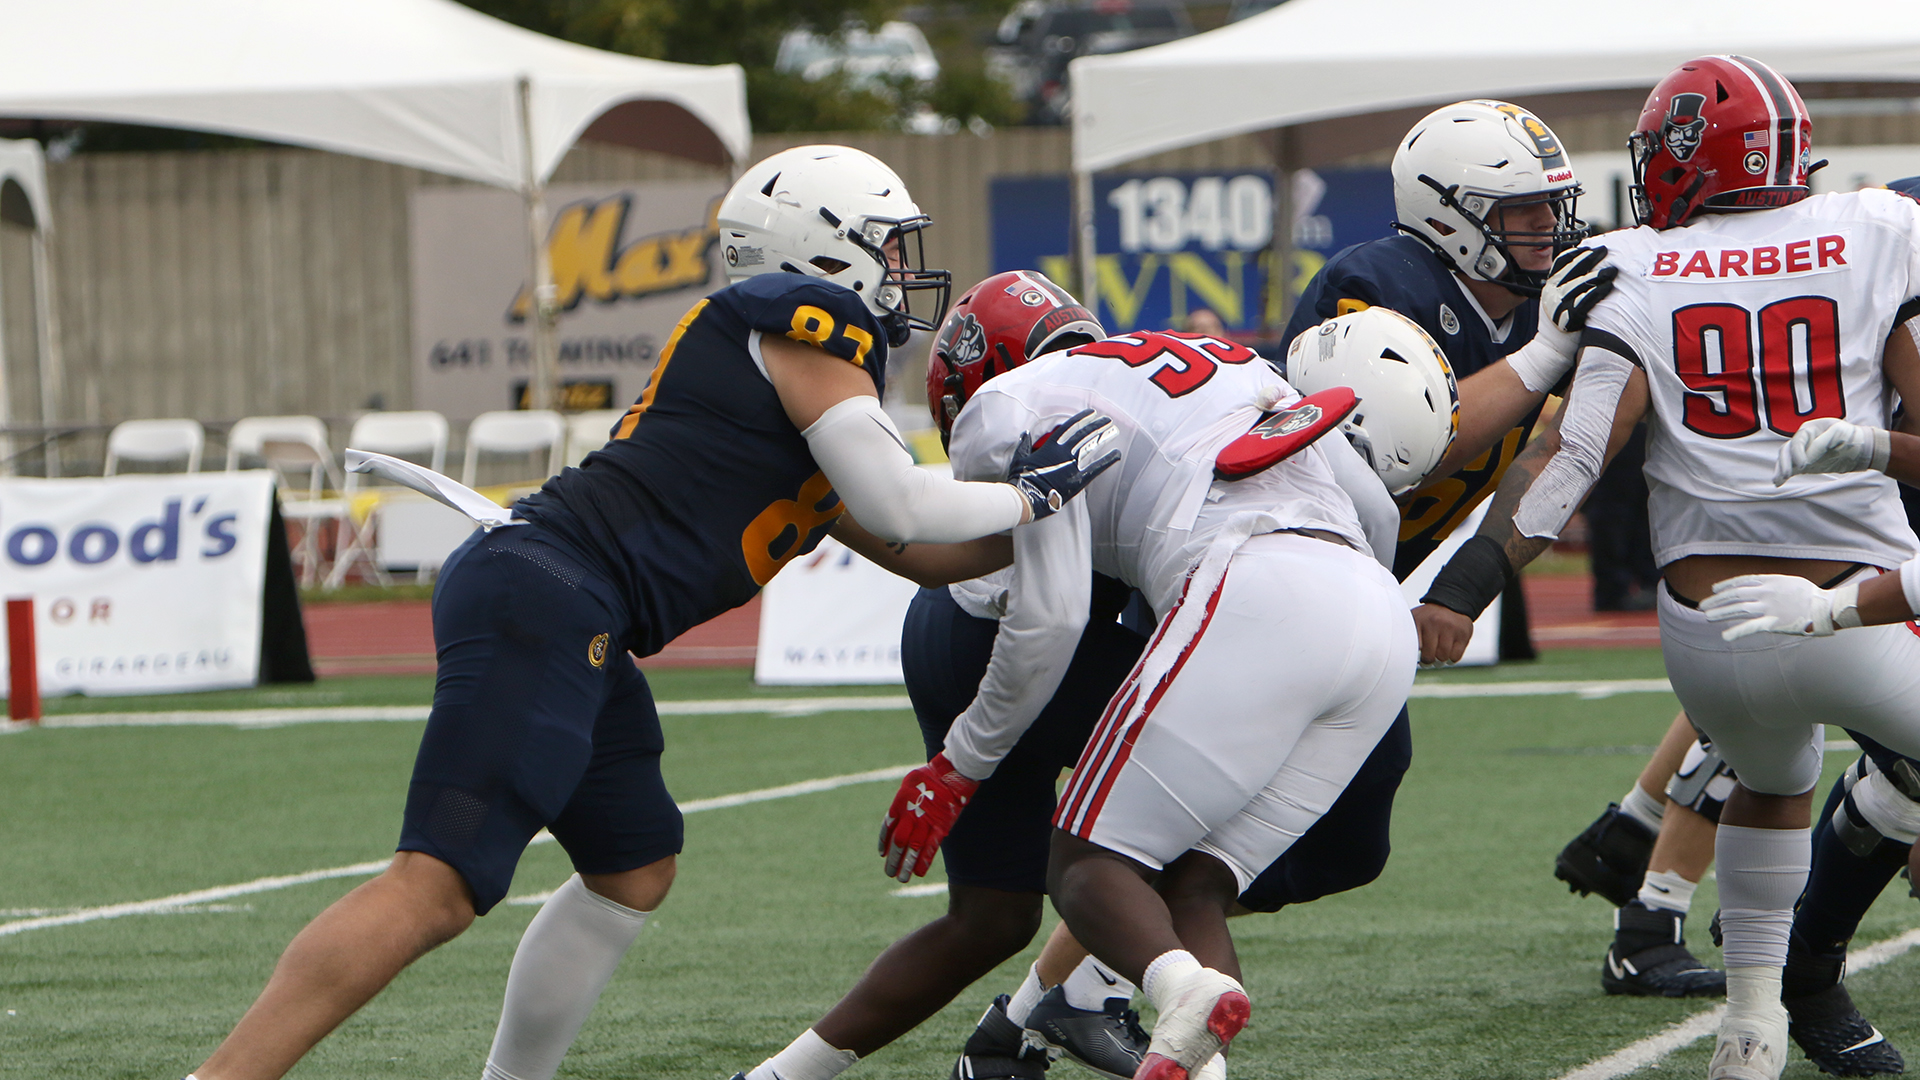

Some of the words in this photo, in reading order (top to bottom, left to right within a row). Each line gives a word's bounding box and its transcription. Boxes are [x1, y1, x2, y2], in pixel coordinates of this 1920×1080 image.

[1111, 174, 1272, 252] 1340
[1735, 190, 1790, 206] AUSTIN
[1651, 234, 1848, 279] BARBER
[785, 304, 875, 367] 87
[1043, 306, 1091, 333] AUSTIN
[1671, 294, 1846, 440] 90
[6, 494, 237, 567] ood's
